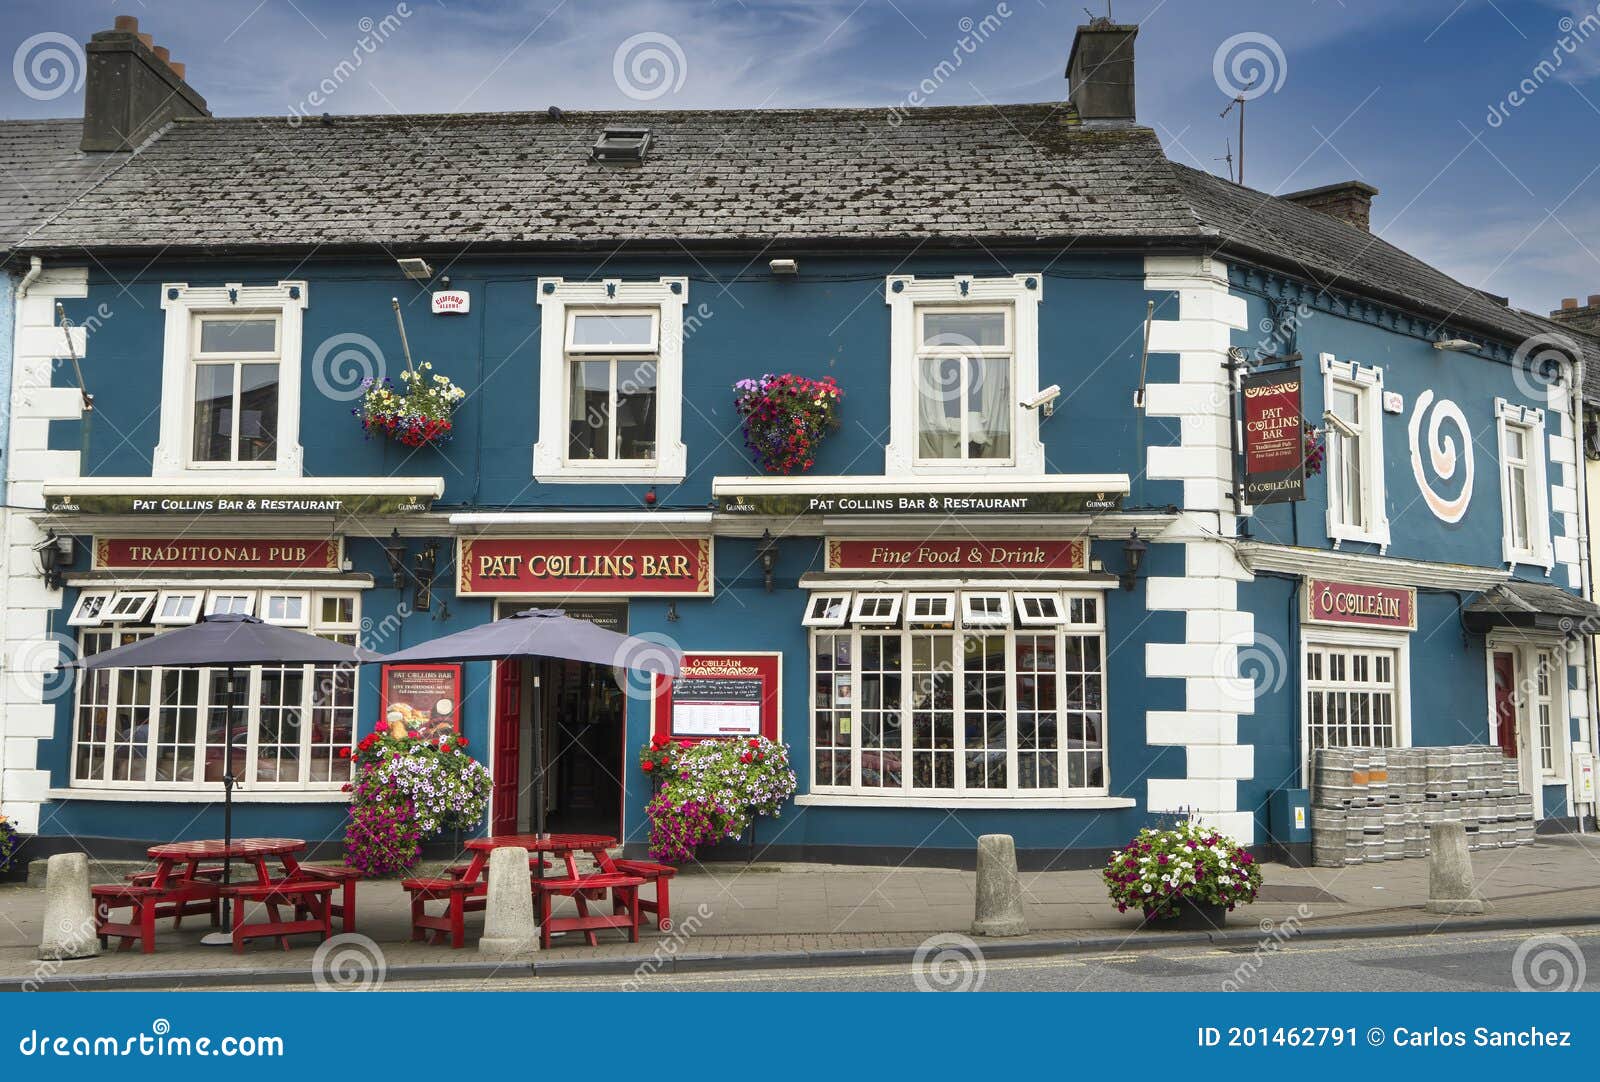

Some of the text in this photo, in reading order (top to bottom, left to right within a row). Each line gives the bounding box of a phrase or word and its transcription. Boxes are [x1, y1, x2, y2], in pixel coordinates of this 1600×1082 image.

[1262, 407, 1283, 419] PAT
[1247, 416, 1299, 432] COLLINS
[1262, 429, 1284, 440] BAR
[1257, 480, 1301, 492] COILEÁIN
[52, 503, 80, 511] GUINNESS
[246, 500, 256, 510] &
[398, 503, 426, 511] GUINNESS
[726, 503, 755, 511] GUINNESS
[928, 498, 939, 508] &
[1086, 499, 1116, 508] GUINNESS
[129, 547, 307, 561] TRADITIONAL PUB
[870, 547, 1046, 564] Fine Food & Drink
[479, 555, 692, 577] PAT COLLINS BAR
[1321, 586, 1400, 618] Ó COILEÁIN
